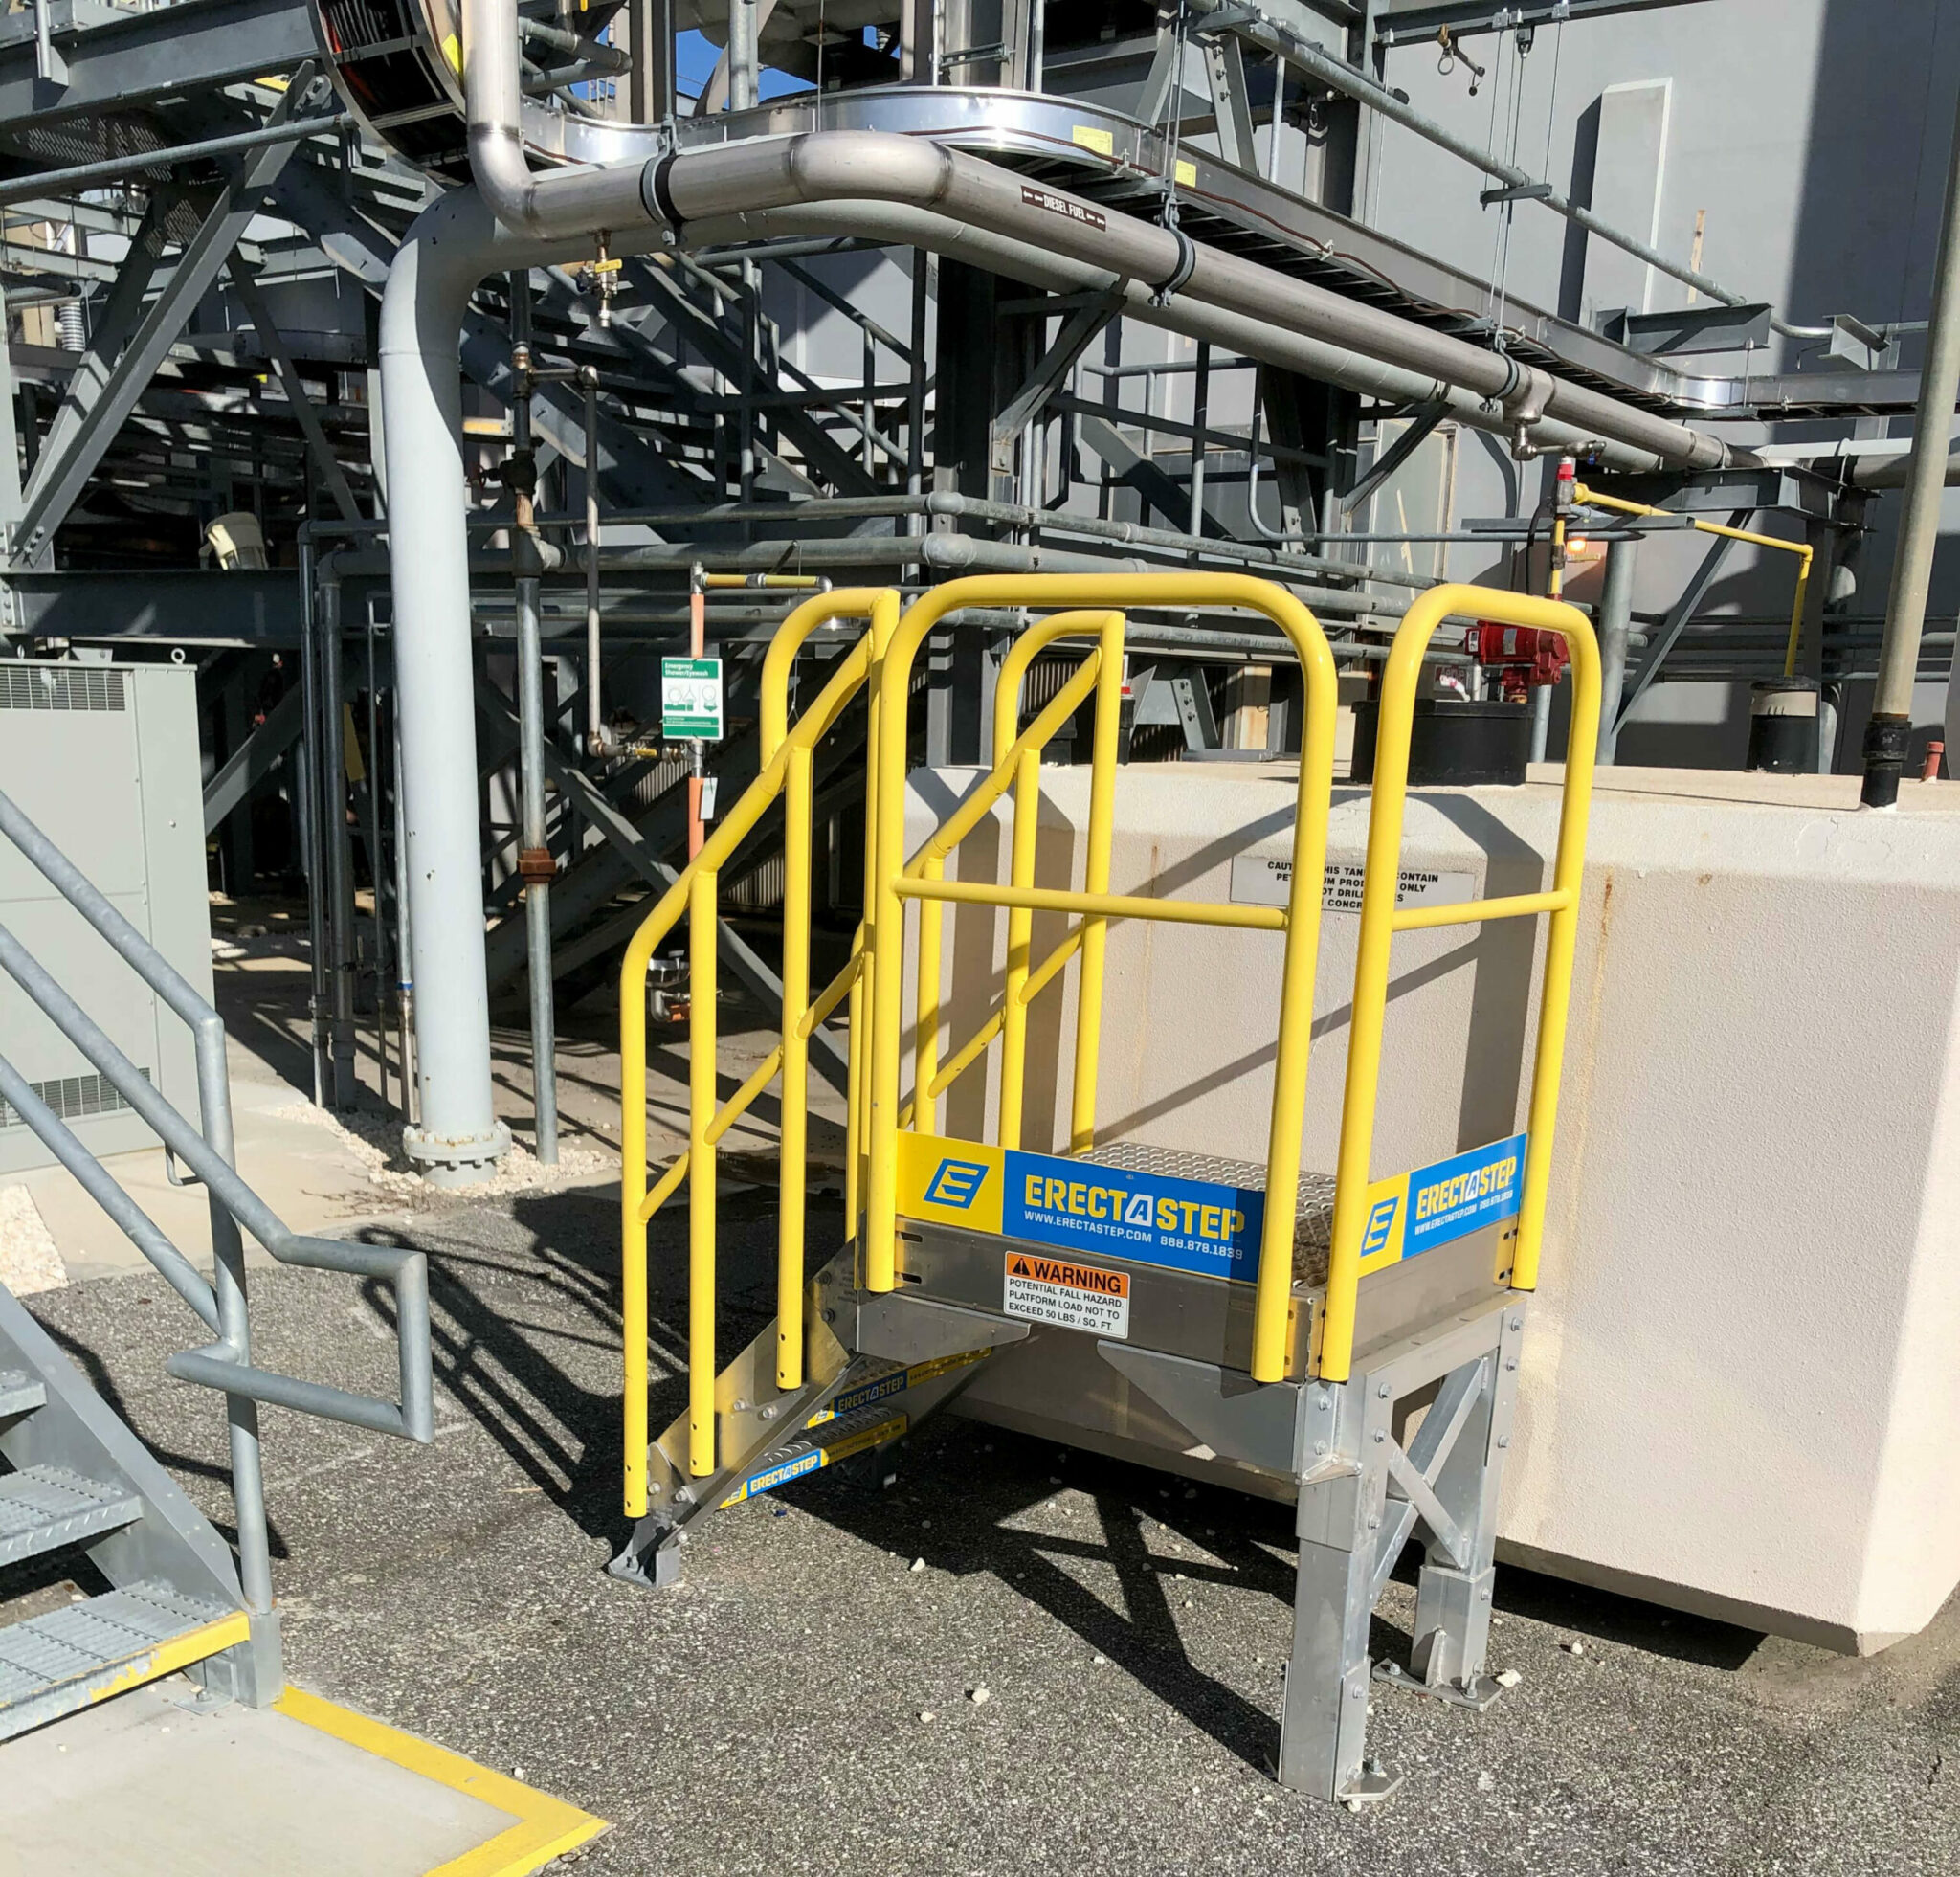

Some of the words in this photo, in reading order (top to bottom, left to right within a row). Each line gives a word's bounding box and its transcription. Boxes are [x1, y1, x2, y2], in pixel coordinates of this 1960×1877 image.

[1043, 195, 1068, 214] DIESEL
[1068, 204, 1087, 221] FUEL
[1267, 861, 1292, 871] CAUT
[1324, 866, 1340, 875] HIS
[1344, 867, 1366, 877] TAN
[1397, 872, 1438, 883] ONTAIN
[1399, 883, 1426, 892] ONLY
[1327, 899, 1362, 908] CONCR
[1024, 1210, 1152, 1243] WWW.ERECTASTEP.COM
[1160, 1235, 1243, 1260] 888.878.1839
[1033, 1261, 1121, 1294] WARNING
[1009, 1278, 1058, 1295] POTENTIAL
[1059, 1288, 1081, 1300] FALL
[1083, 1293, 1125, 1308] HAZARD.
[1009, 1290, 1057, 1307] PLATFORM
[1058, 1300, 1083, 1312] LOAD
[1085, 1306, 1103, 1318] NOT
[1107, 1309, 1120, 1320] TO
[1009, 1302, 1044, 1316] EXCEED
[1045, 1309, 1057, 1319] 50
[1058, 1311, 1075, 1324] LBS
[1082, 1317, 1099, 1329] SQ.
[1101, 1321, 1113, 1331] FT.
